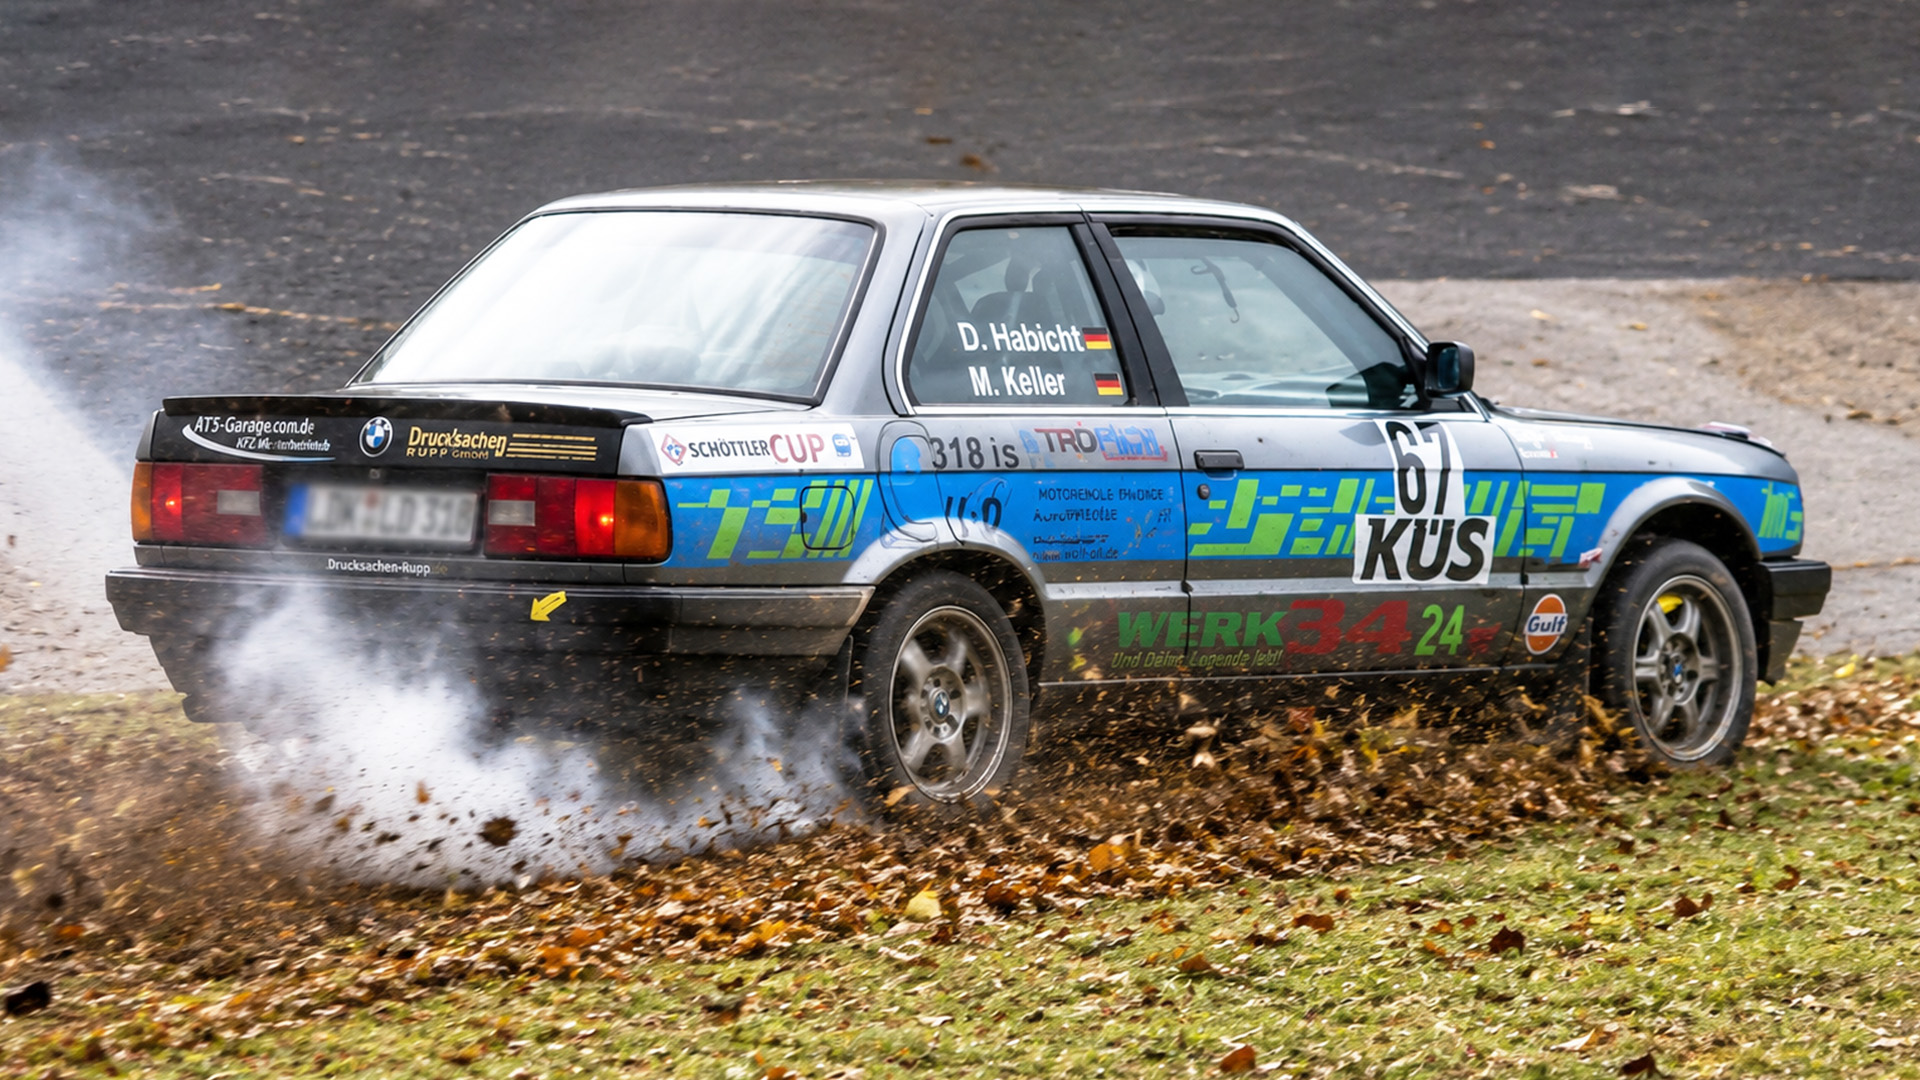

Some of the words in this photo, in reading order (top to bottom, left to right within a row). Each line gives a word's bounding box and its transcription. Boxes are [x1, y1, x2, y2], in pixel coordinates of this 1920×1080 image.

[957, 322, 988, 351] D.
[989, 322, 1085, 352] Habicht
[968, 366, 1000, 396] M.
[1001, 366, 1066, 396] Keller
[406, 447, 447, 458] RUPP
[688, 437, 770, 459] SCHÖTTLER
[769, 433, 825, 464] CUP
[930, 436, 985, 469] 318
[990, 436, 1020, 469] is
[1385, 421, 1451, 515] 67
[1360, 517, 1490, 582] KÜS
[1118, 611, 1287, 648] WERK
[1414, 603, 1465, 656] 24
[1527, 613, 1566, 634] Gulf
